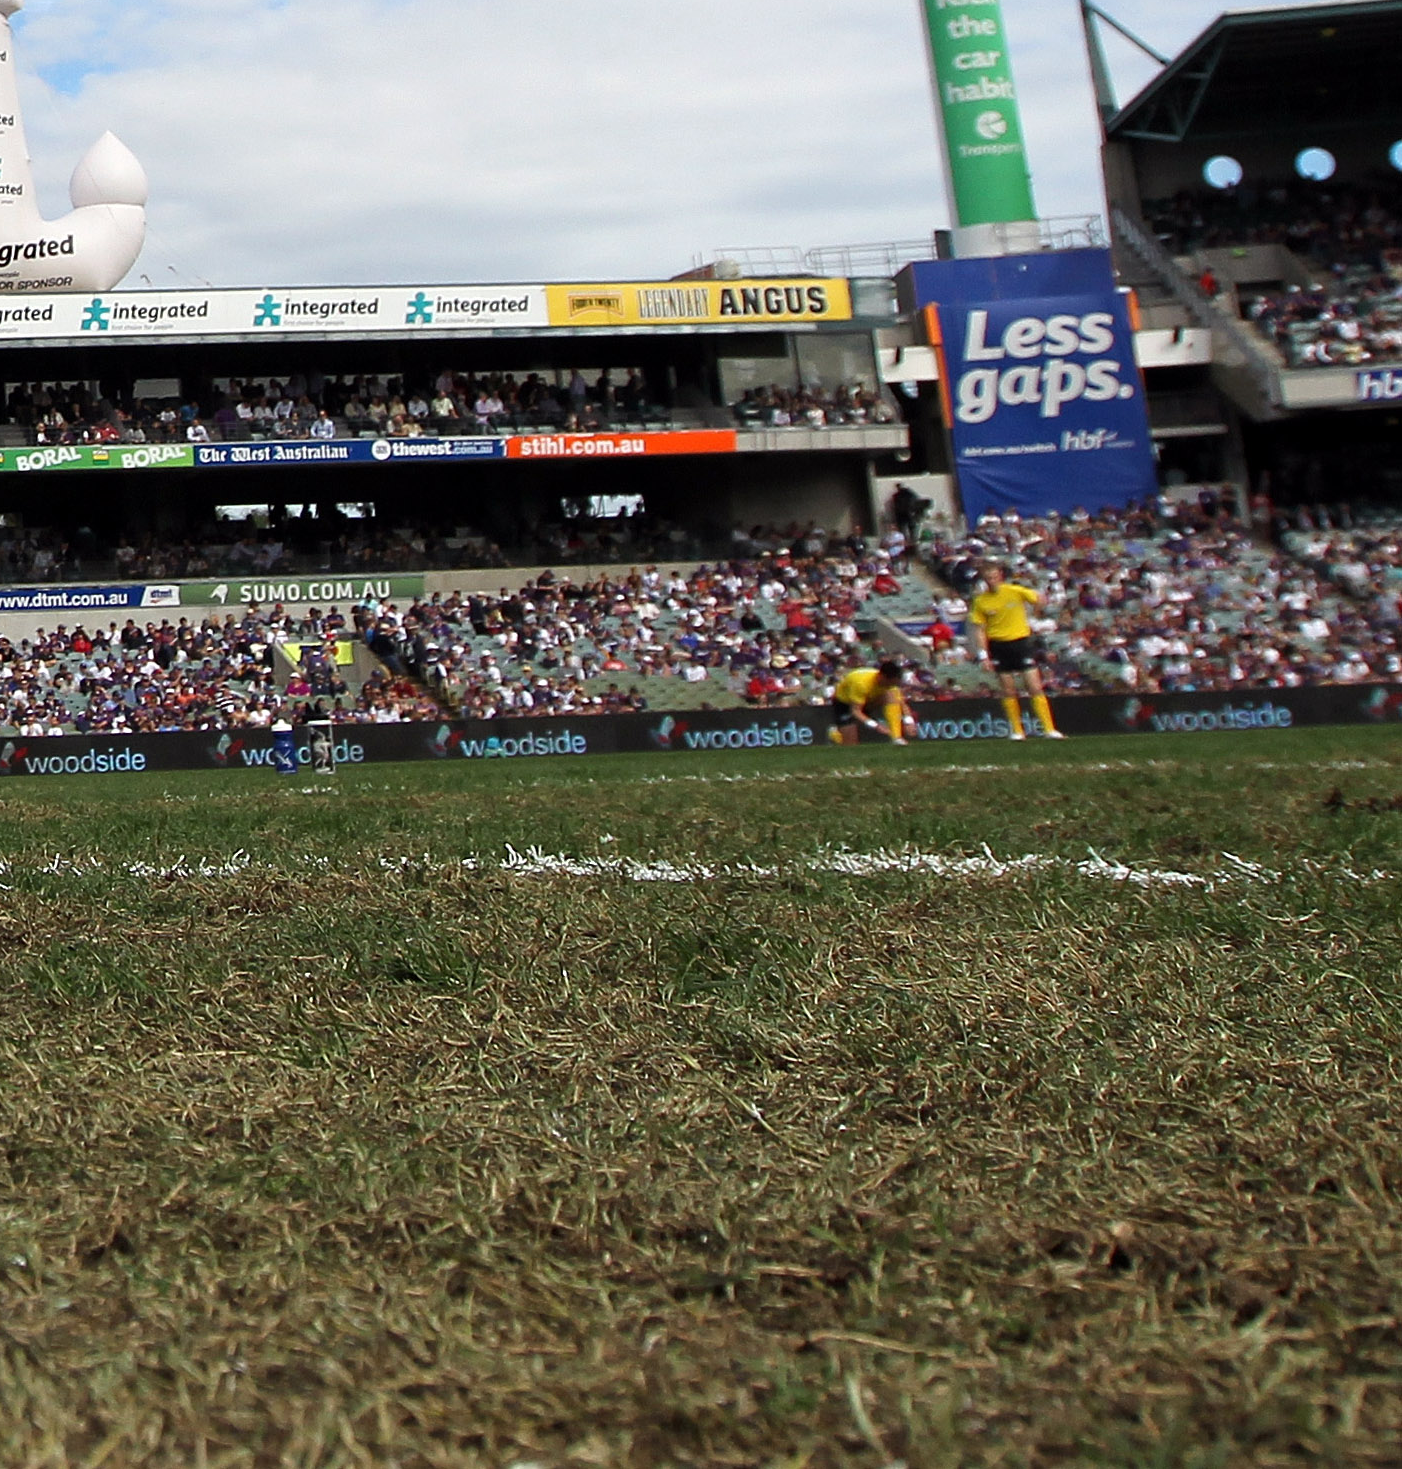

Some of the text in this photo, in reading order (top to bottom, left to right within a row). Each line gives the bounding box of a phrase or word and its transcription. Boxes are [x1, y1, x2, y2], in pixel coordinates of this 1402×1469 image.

[947, 15, 996, 39] the
[953, 51, 1000, 70] car
[946, 76, 1016, 104] habit
[17, 276, 73, 290] SPONSOR
[113, 300, 209, 323] integrated
[285, 297, 379, 319] integrated
[437, 295, 529, 316] integrated
[638, 289, 709, 318] LEGENDARY
[720, 286, 828, 316] ANGUS
[964, 309, 1114, 362] Less
[955, 357, 1135, 424] gaps.
[1358, 371, 1402, 400] hb
[392, 441, 494, 457] thewest.com.au
[520, 436, 645, 455] stihl.com.au
[1061, 428, 1107, 452] hbf
[16, 446, 82, 471] BORAL
[121, 444, 186, 469] BORAL
[199, 444, 349, 464] The West Australian
[240, 581, 390, 603] SUMO.COM.AU
[1156, 702, 1293, 732] woodside
[460, 730, 587, 758] wodside
[684, 721, 813, 750] woodside
[25, 748, 145, 774] woodside
